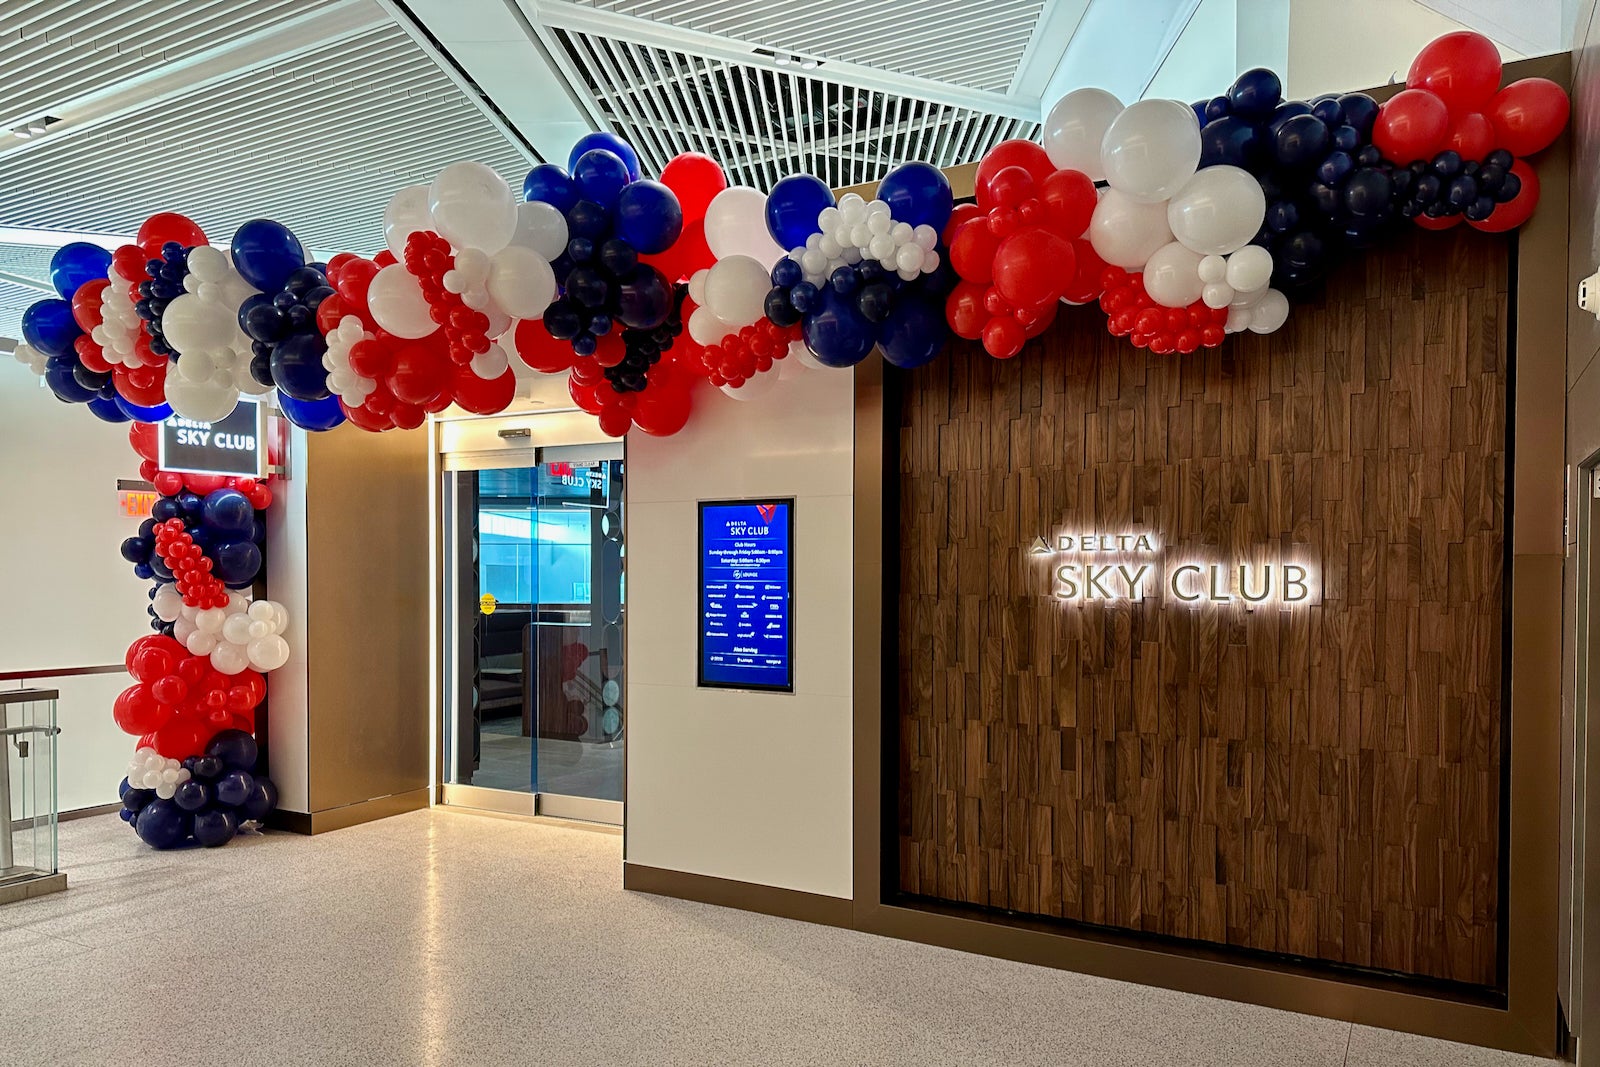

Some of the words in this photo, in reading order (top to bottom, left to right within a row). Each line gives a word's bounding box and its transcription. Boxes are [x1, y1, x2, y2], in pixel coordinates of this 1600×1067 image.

[177, 429, 211, 446] SKY
[214, 433, 256, 450] CLUB
[127, 493, 155, 516] EXIT
[730, 527, 746, 535] SKY
[747, 526, 769, 535] CLUB
[1057, 534, 1152, 552] DELTA
[1056, 564, 1149, 600] SKY
[1170, 564, 1308, 602] CLUB
